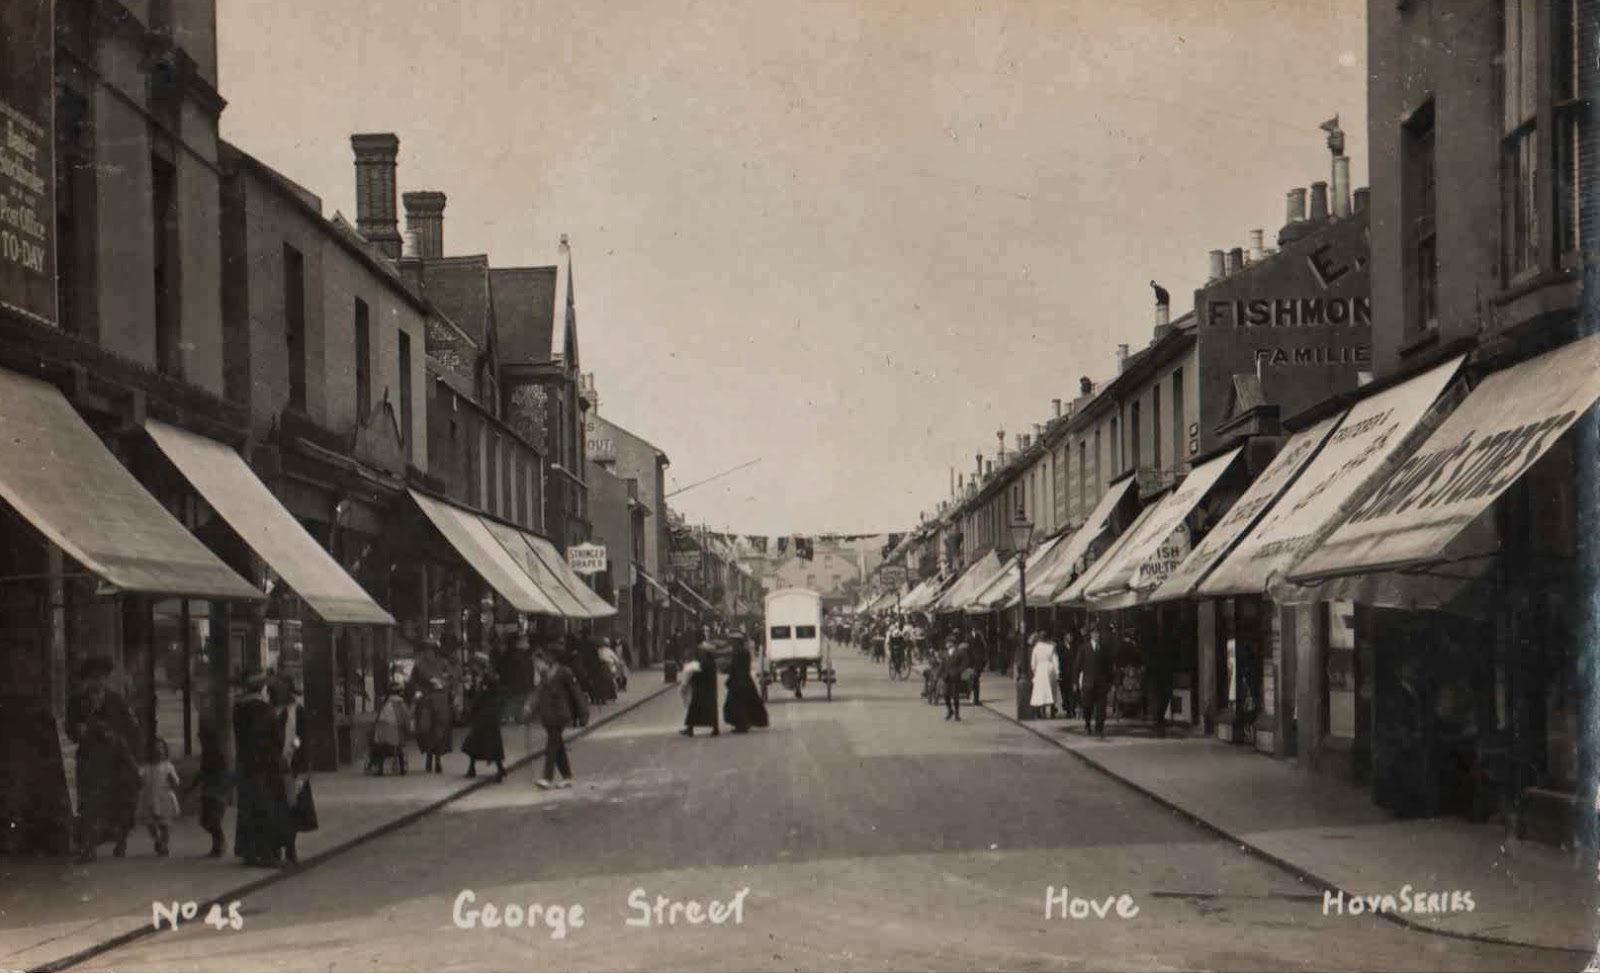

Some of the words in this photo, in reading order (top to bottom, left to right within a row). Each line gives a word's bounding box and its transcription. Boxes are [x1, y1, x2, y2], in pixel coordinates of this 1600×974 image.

[1207, 297, 1371, 327] FISHMON
[1418, 410, 1577, 510] STORES
[571, 559, 603, 568] DRAPER
[1148, 545, 1179, 560] ISH
